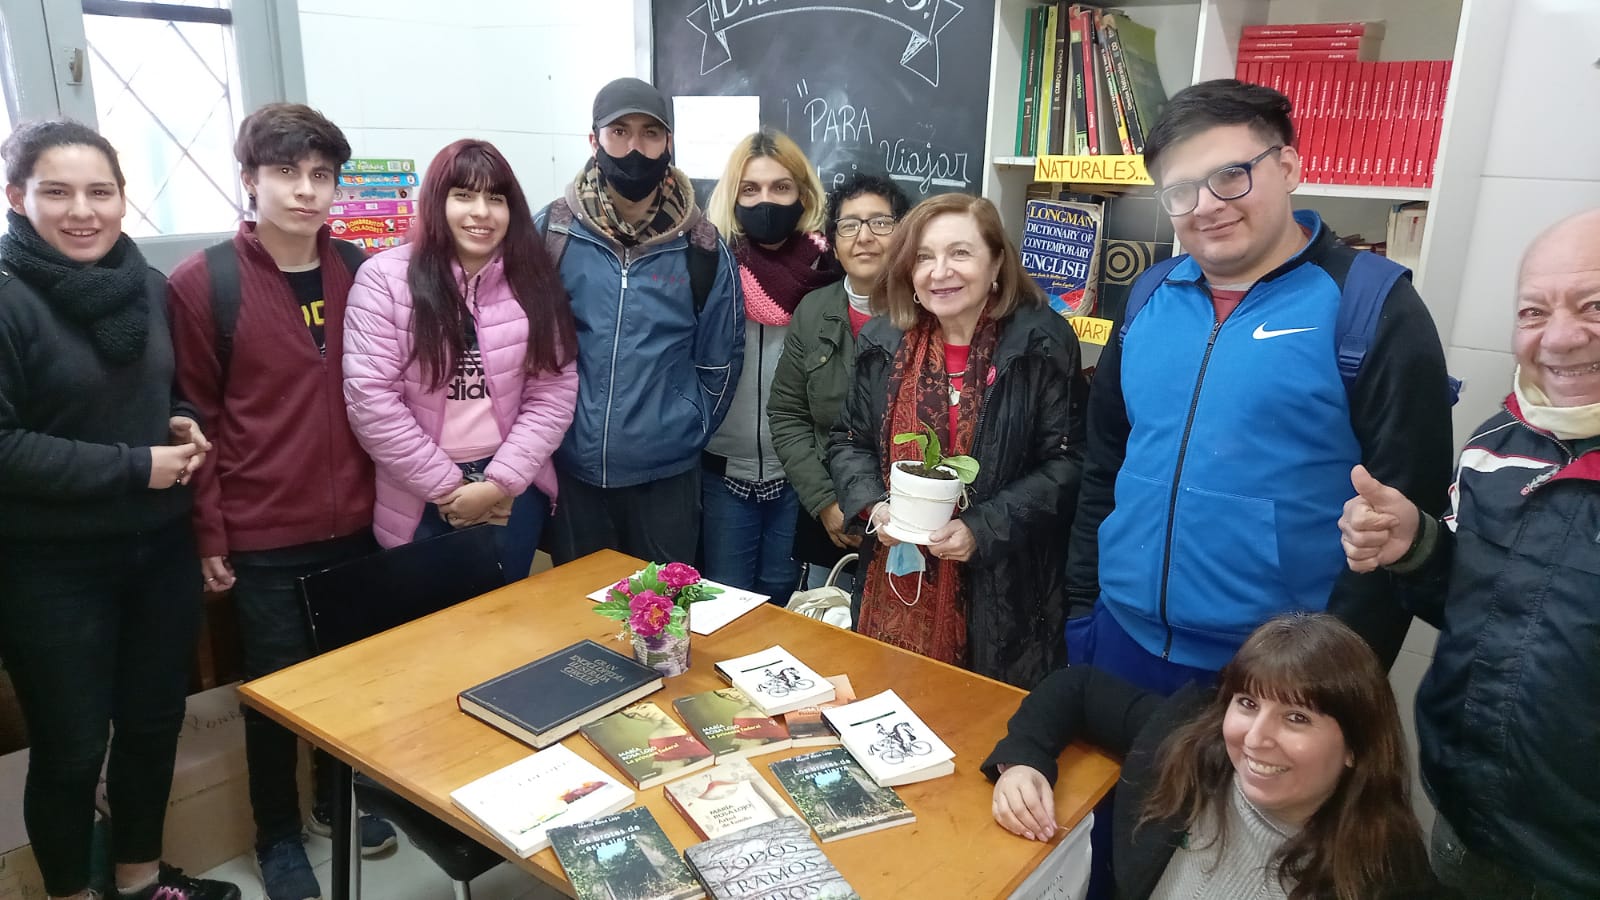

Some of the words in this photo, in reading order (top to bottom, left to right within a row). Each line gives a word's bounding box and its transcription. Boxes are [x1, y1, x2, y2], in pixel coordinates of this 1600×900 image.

[880, 138, 970, 194] Viajar
[1029, 205, 1094, 229] LONGMAN
[1026, 222, 1080, 241] DICTIONARY
[1081, 232, 1094, 243] OF
[1023, 236, 1092, 259] CONTEMPORARY
[1021, 251, 1088, 279] ENGLISH
[446, 378, 491, 401] did
[791, 767, 809, 776] Los
[572, 838, 591, 847] Los
[592, 829, 626, 842] brotes
[627, 824, 641, 833] de
[718, 843, 799, 876] TODOS
